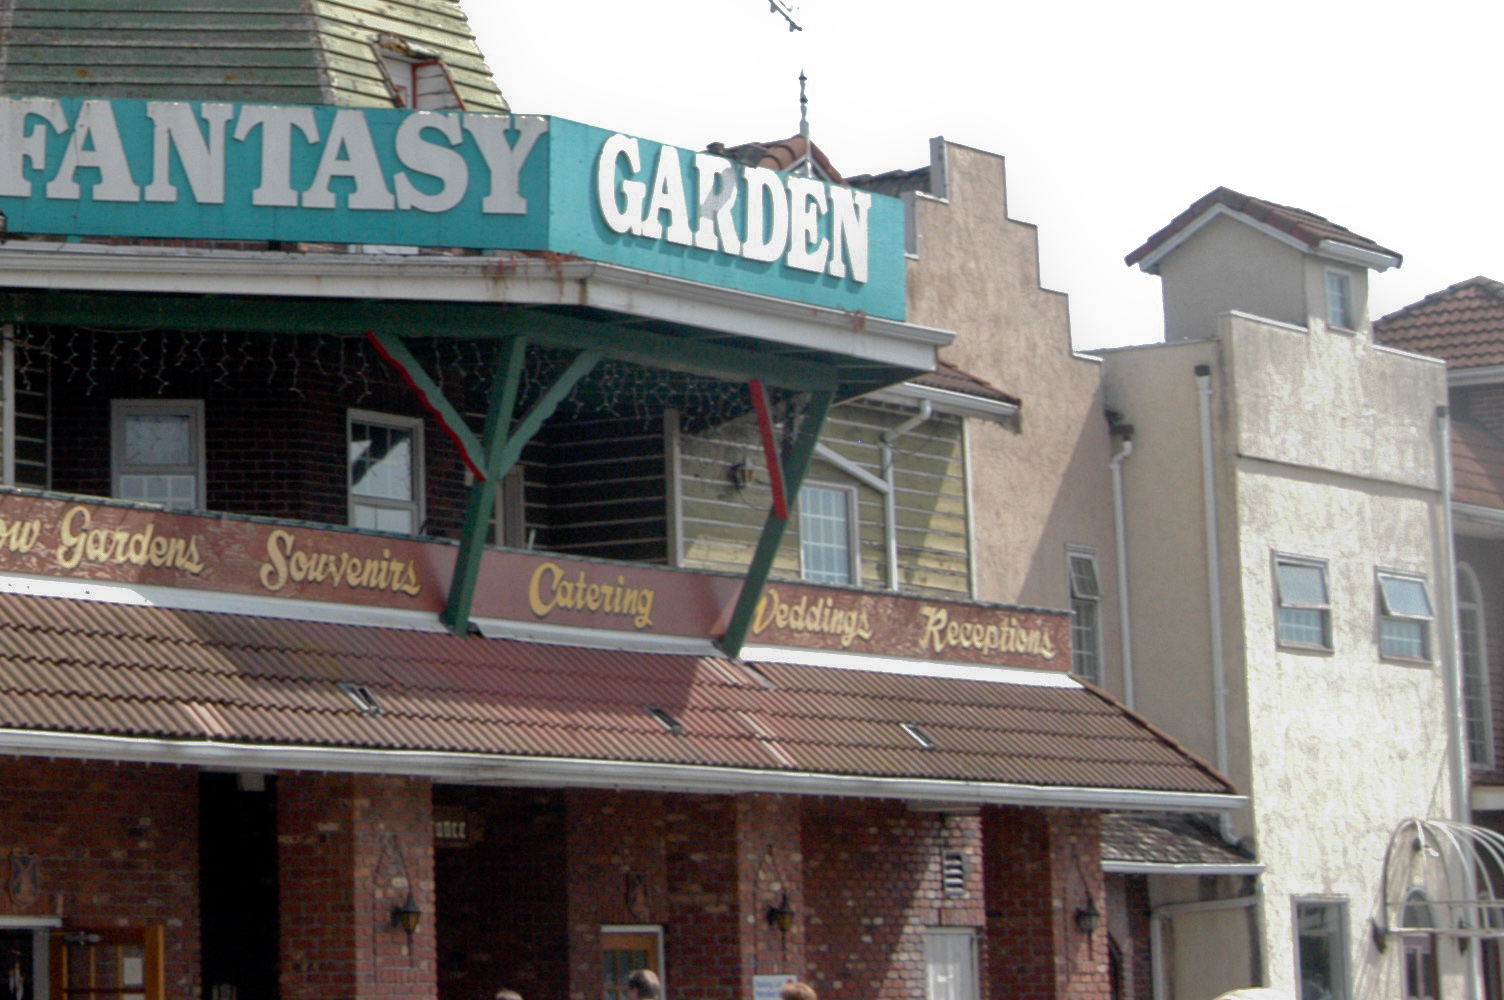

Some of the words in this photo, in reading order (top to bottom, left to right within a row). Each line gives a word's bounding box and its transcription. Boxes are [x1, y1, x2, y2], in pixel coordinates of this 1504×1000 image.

[596, 131, 872, 284] GARDEN
[56, 504, 204, 573] Gardens
[258, 528, 422, 595] Souvenirs
[527, 561, 655, 629] Catering
[917, 606, 1056, 659] Receptions
